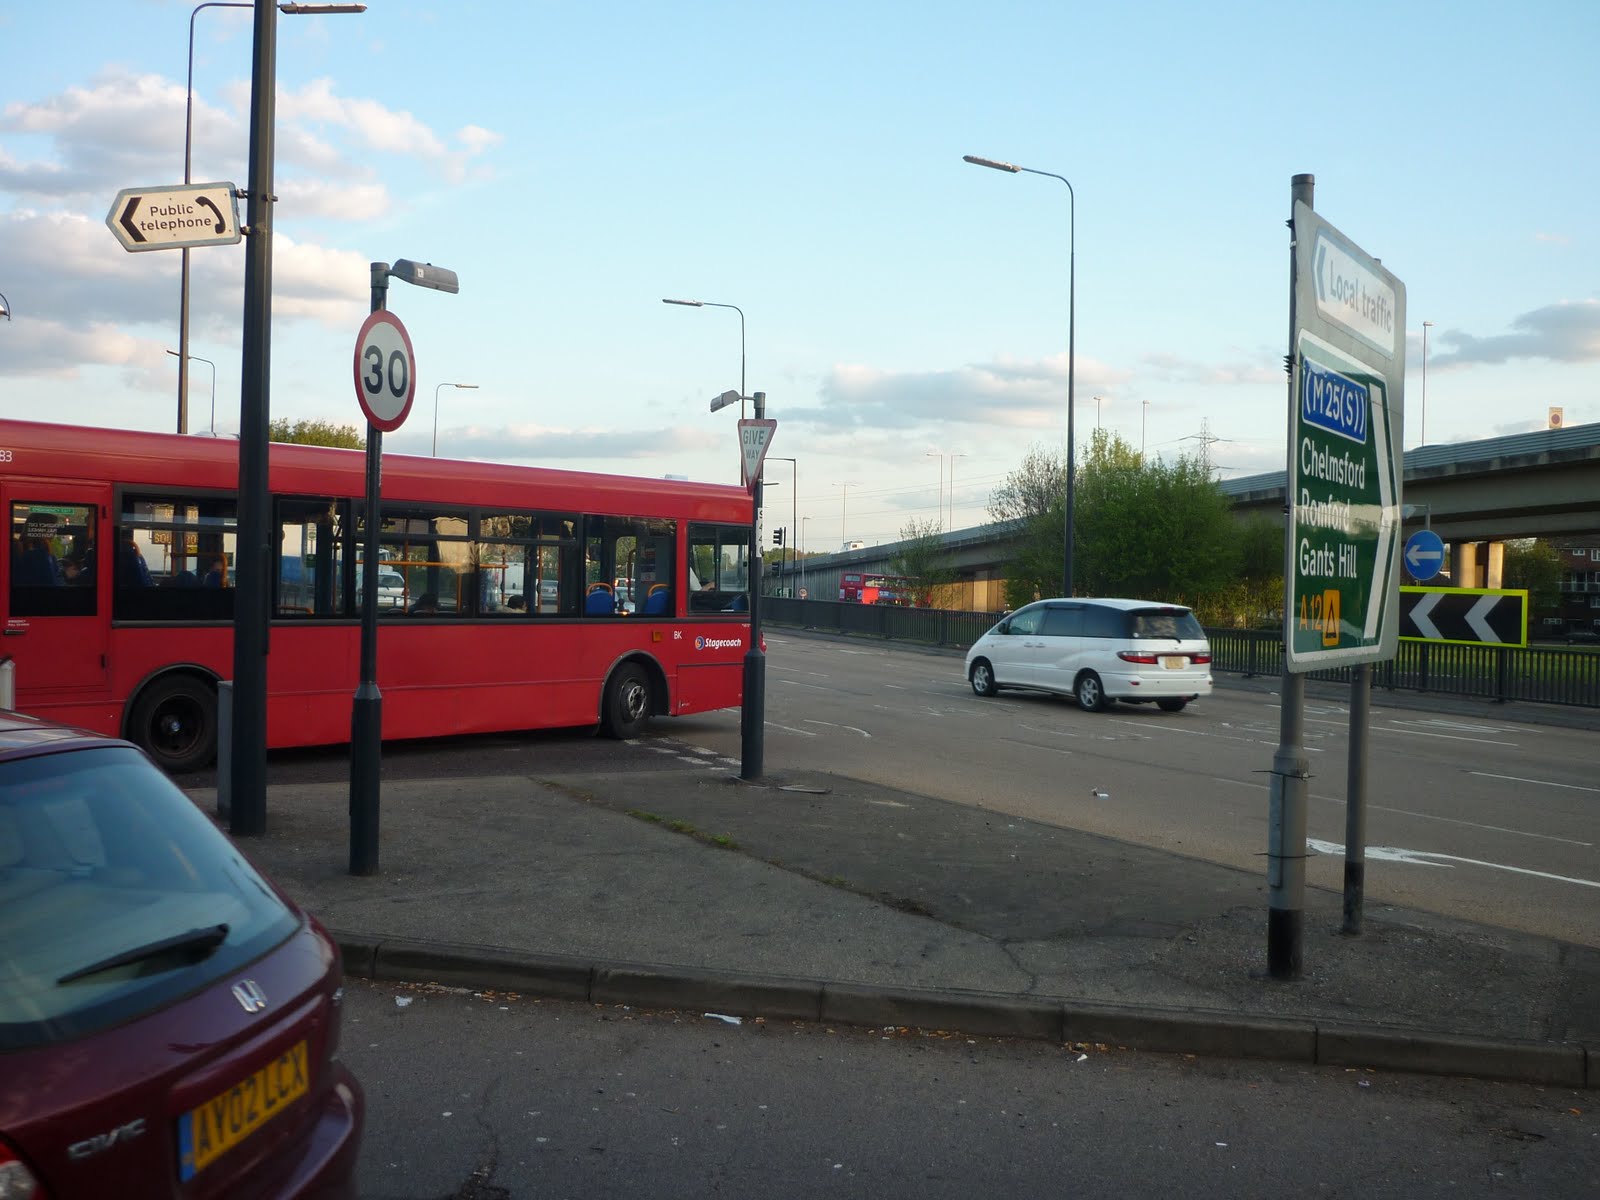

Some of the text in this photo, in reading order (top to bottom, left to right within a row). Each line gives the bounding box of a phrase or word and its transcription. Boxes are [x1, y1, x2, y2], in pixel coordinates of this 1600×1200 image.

[150, 204, 194, 217] Public
[140, 217, 212, 231] telephone
[1330, 260, 1392, 333] Local traffic
[364, 345, 408, 398] 30
[743, 430, 765, 445] GIVE
[746, 449, 760, 460] WAY
[1301, 437, 1365, 489] Chelmsford
[1301, 488, 1351, 530] Romford
[1300, 538, 1358, 578] Gants Hill
[673, 630, 683, 640] BK
[705, 638, 742, 650] Stagecoach
